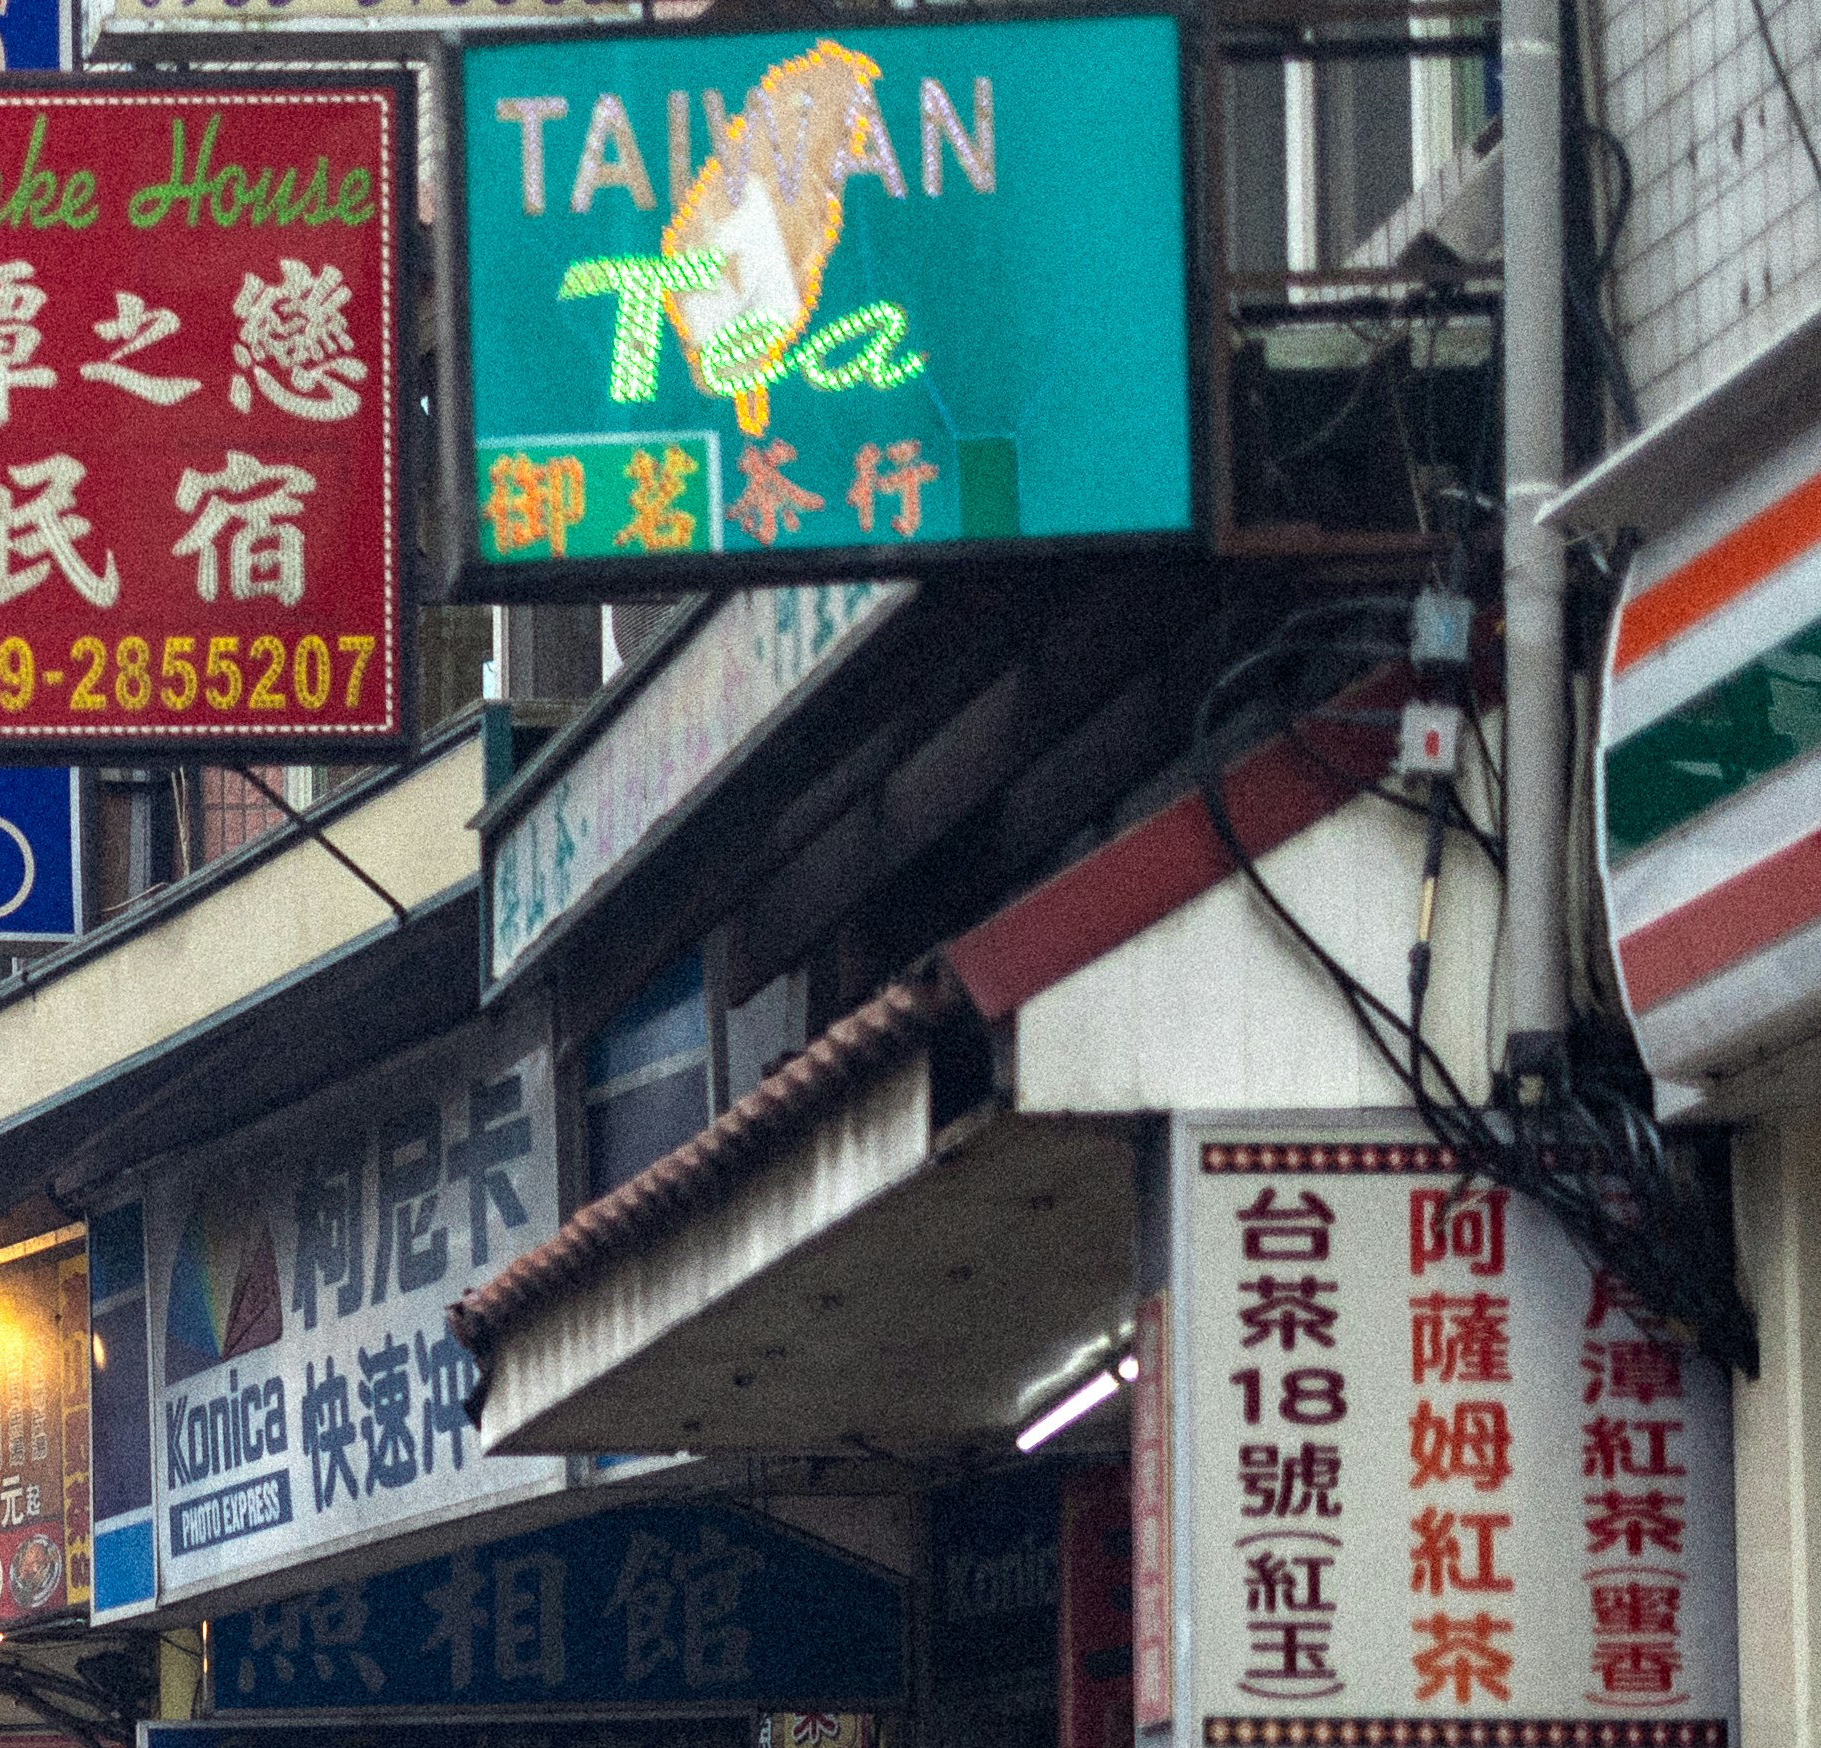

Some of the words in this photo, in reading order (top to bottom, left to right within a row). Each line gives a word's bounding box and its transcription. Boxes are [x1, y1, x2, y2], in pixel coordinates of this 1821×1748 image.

[129, 112, 378, 231] House
[496, 76, 996, 215] TAIWAN
[558, 247, 927, 403] Tea
[484, 438, 938, 556] 御茗茶行
[291, 1076, 534, 1334] 柯尼卡
[165, 1367, 288, 1489] Konica
[1408, 1187, 1515, 1705] 阿薩姆紅茶
[181, 1493, 224, 1550] PHOTO
[225, 1474, 282, 1537] EXPRESS
